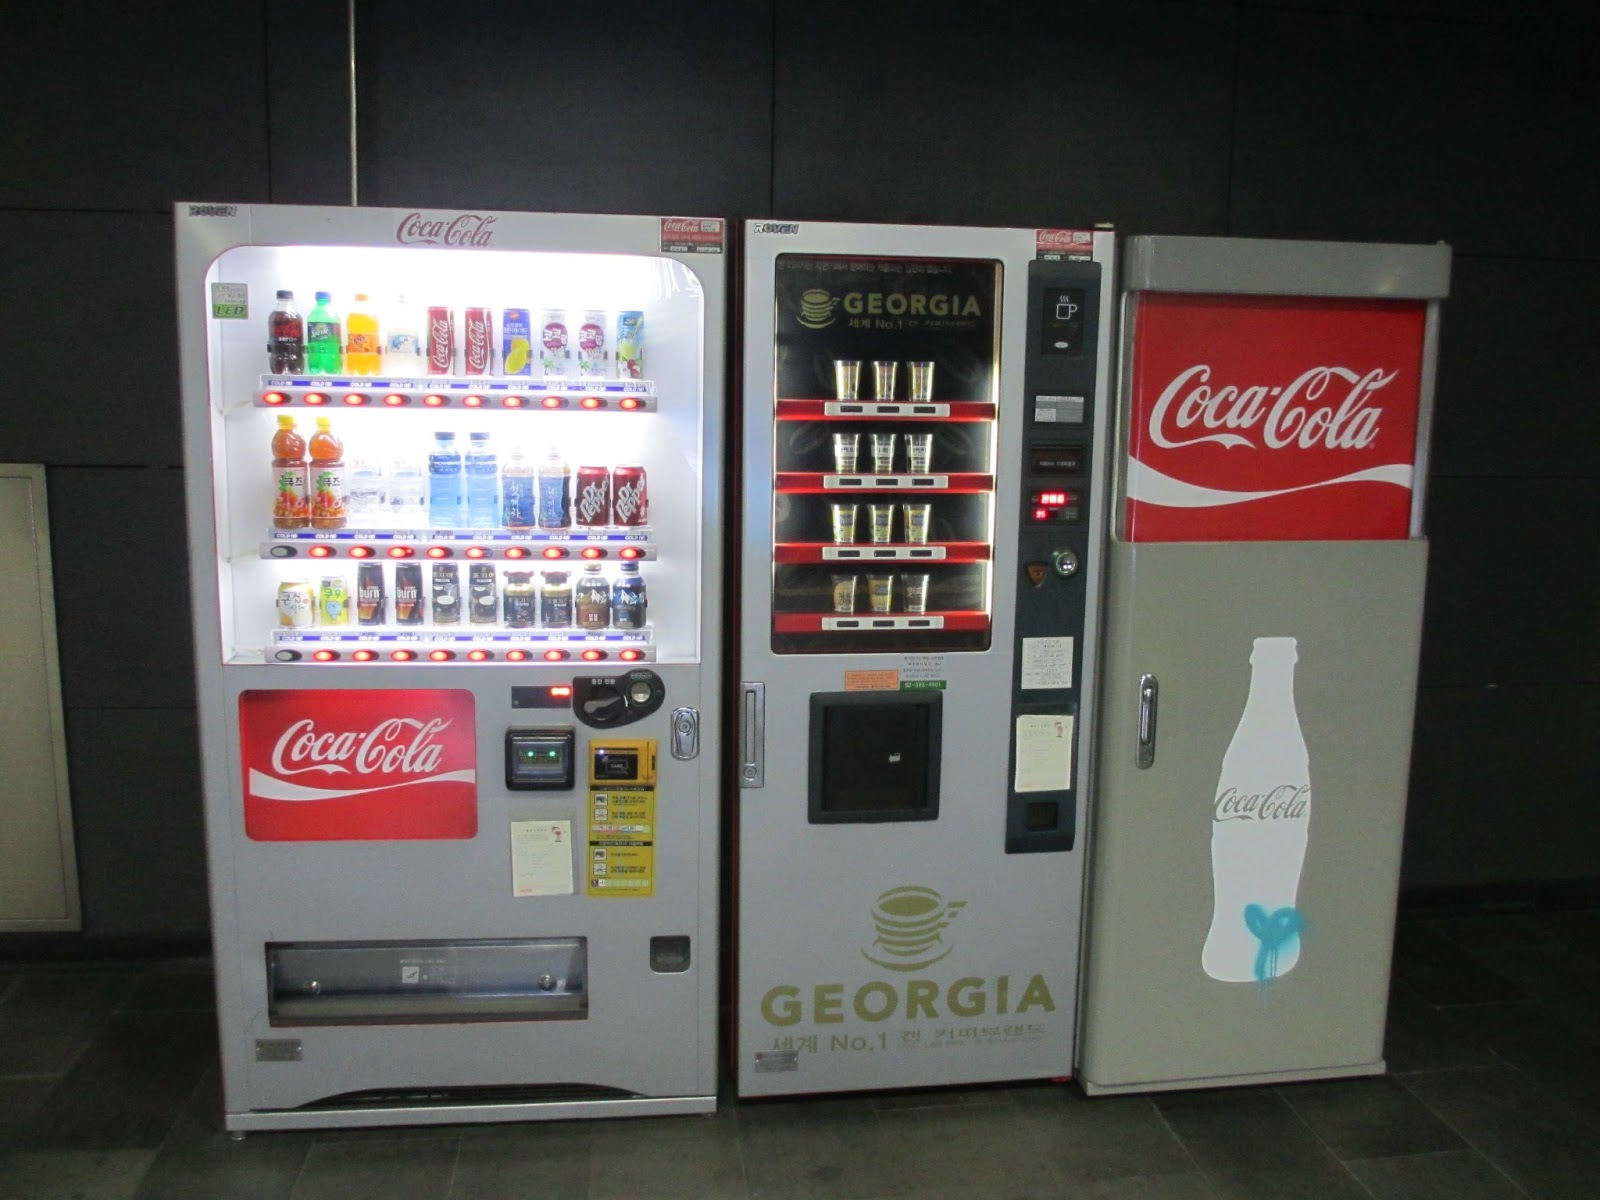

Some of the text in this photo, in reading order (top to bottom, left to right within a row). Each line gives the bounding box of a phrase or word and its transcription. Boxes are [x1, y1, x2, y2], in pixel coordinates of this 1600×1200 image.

[396, 212, 499, 247] Coca-Cola
[754, 223, 799, 235] ROVEN
[216, 306, 245, 315] LED
[843, 291, 982, 317] GEORGIA
[875, 318, 904, 330] No.1
[1149, 364, 1399, 450] Coca-Cola
[582, 481, 597, 502] Dr
[618, 481, 633, 502] Dr
[359, 586, 380, 599] burn
[396, 586, 418, 599] burn
[271, 717, 454, 776] Coca-Cola
[1213, 784, 1311, 823] Coca-Cola
[760, 973, 1057, 1028] GEORGIA
[772, 1033, 818, 1054] 세계
[830, 1032, 888, 1052] No.1
